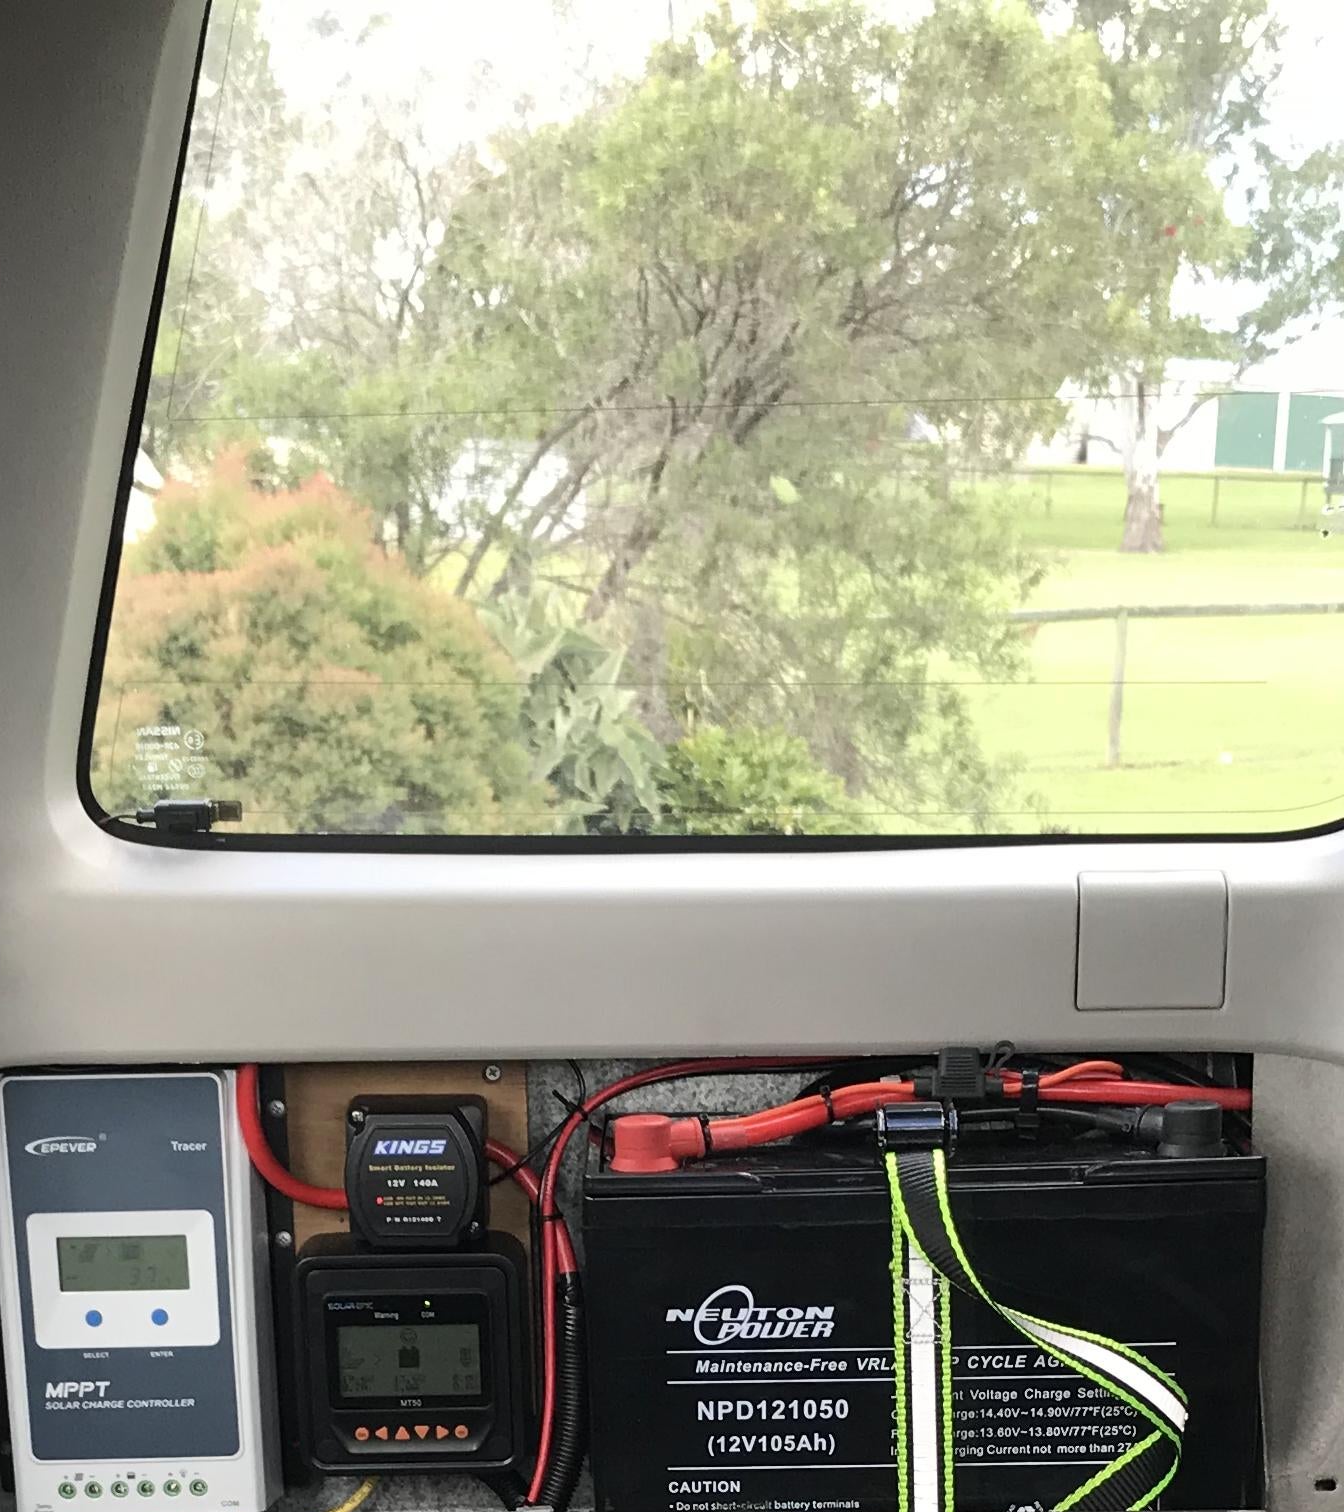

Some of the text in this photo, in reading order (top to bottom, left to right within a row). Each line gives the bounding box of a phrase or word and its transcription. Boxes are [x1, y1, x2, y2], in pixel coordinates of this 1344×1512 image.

[40, 1142, 97, 1154] EPEVER
[170, 1140, 207, 1151] Tracer
[374, 1139, 447, 1155] KINGS
[387, 1178, 439, 1187] 12V 140A
[374, 1311, 399, 1320] Warning
[665, 1306, 835, 1322] NEUTON
[717, 1321, 835, 1339] POWER
[150, 1350, 175, 1358] ENTER
[695, 1357, 848, 1374] Maintenance-Free
[967, 1355, 1028, 1369] CYCLE
[1033, 1354, 1064, 1368] AG
[45, 1381, 111, 1399] MPPT
[970, 1388, 1018, 1402] Voltage
[1024, 1387, 1071, 1401] Charge
[45, 1398, 195, 1410] SOLAR CHARGE CONTROLLER
[697, 1399, 849, 1421] NPD121050
[707, 1432, 836, 1457] (12V105Ah)
[986, 1444, 1031, 1455] Current
[1032, 1445, 1052, 1454] not
[1056, 1444, 1088, 1454] more
[1089, 1443, 1115, 1453] than
[668, 1481, 741, 1494] CAUTION
[676, 1500, 860, 1511] Do not short-circuit battery terminals
